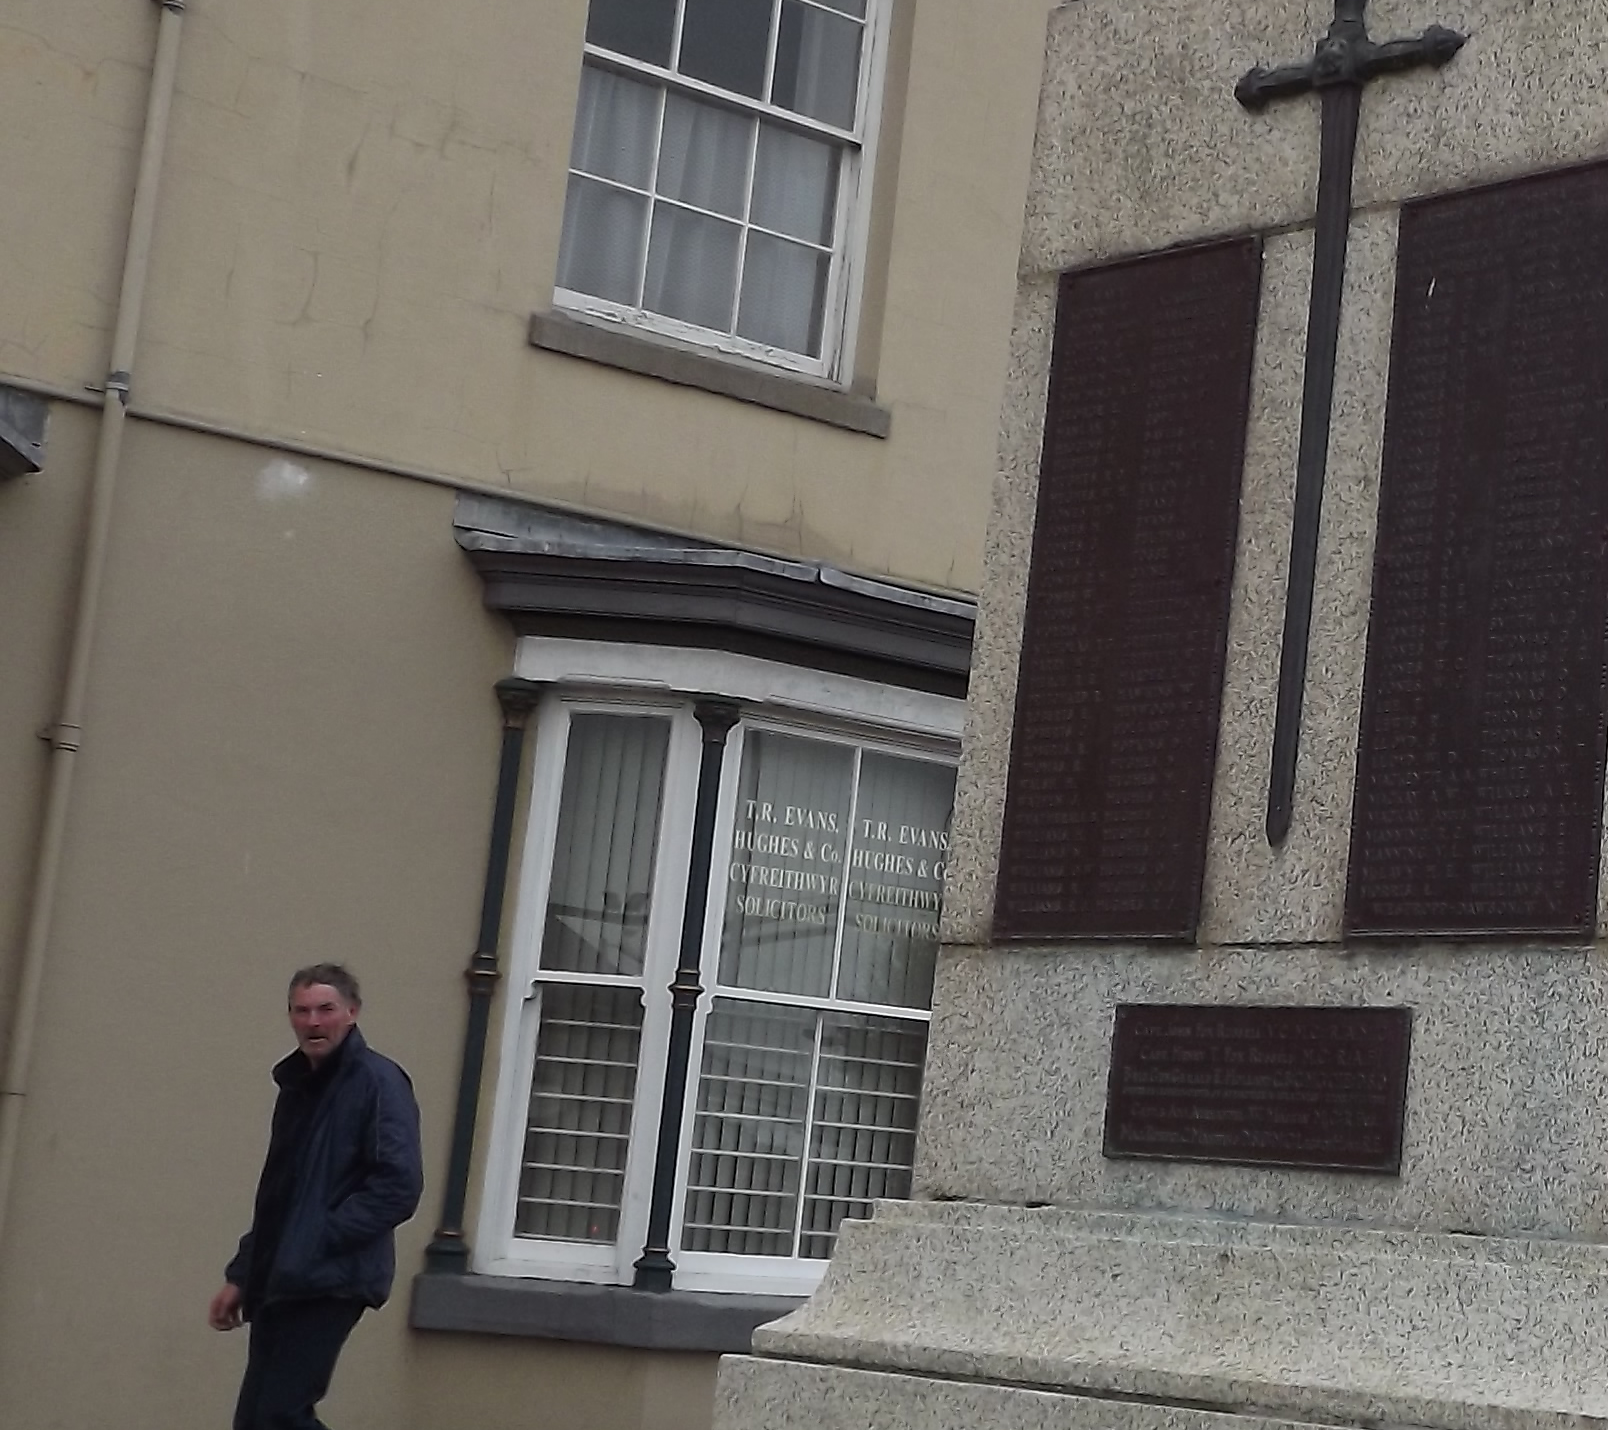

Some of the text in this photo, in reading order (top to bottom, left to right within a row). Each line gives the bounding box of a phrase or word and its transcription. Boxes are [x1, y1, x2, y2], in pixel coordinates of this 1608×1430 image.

[746, 799, 777, 824] T.R.
[733, 830, 799, 858] HUGHES
[803, 841, 815, 860] &
[862, 818, 892, 842] T.R.
[852, 848, 914, 876] HUGHES
[917, 859, 928, 878] &
[729, 862, 838, 896] CYFREITHWYR
[736, 894, 828, 924] SOLICITORS
